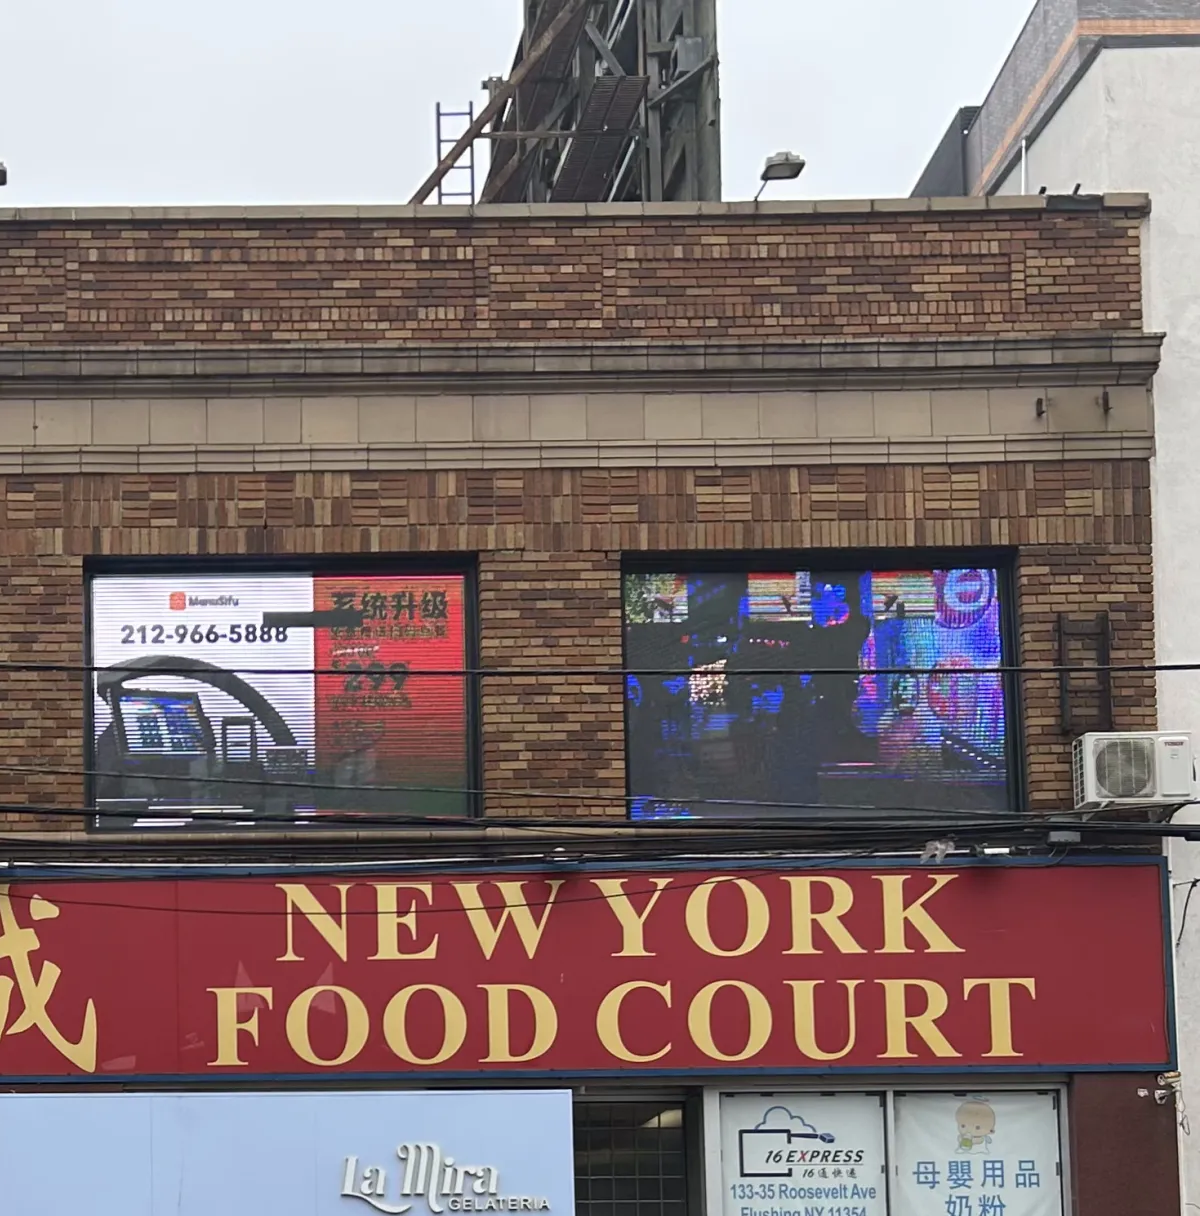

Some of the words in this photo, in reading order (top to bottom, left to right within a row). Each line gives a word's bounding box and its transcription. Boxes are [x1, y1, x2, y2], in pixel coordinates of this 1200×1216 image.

[121, 624, 288, 644] 212-966-5888
[276, 879, 566, 962] NEW
[587, 874, 965, 957] YORK
[206, 984, 559, 1067] FOOD
[596, 977, 1036, 1063] COURT
[765, 1149, 783, 1163] 16
[785, 1149, 865, 1163] EXPRESS
[340, 1155, 411, 1214] La
[396, 1141, 498, 1214] Mira
[912, 1159, 1040, 1189] 母嬰用品
[730, 1184, 775, 1200] 133-35
[778, 1183, 849, 1200] Roosevelt
[850, 1184, 877, 1200] Ave
[448, 1197, 551, 1212] GELATERIA
